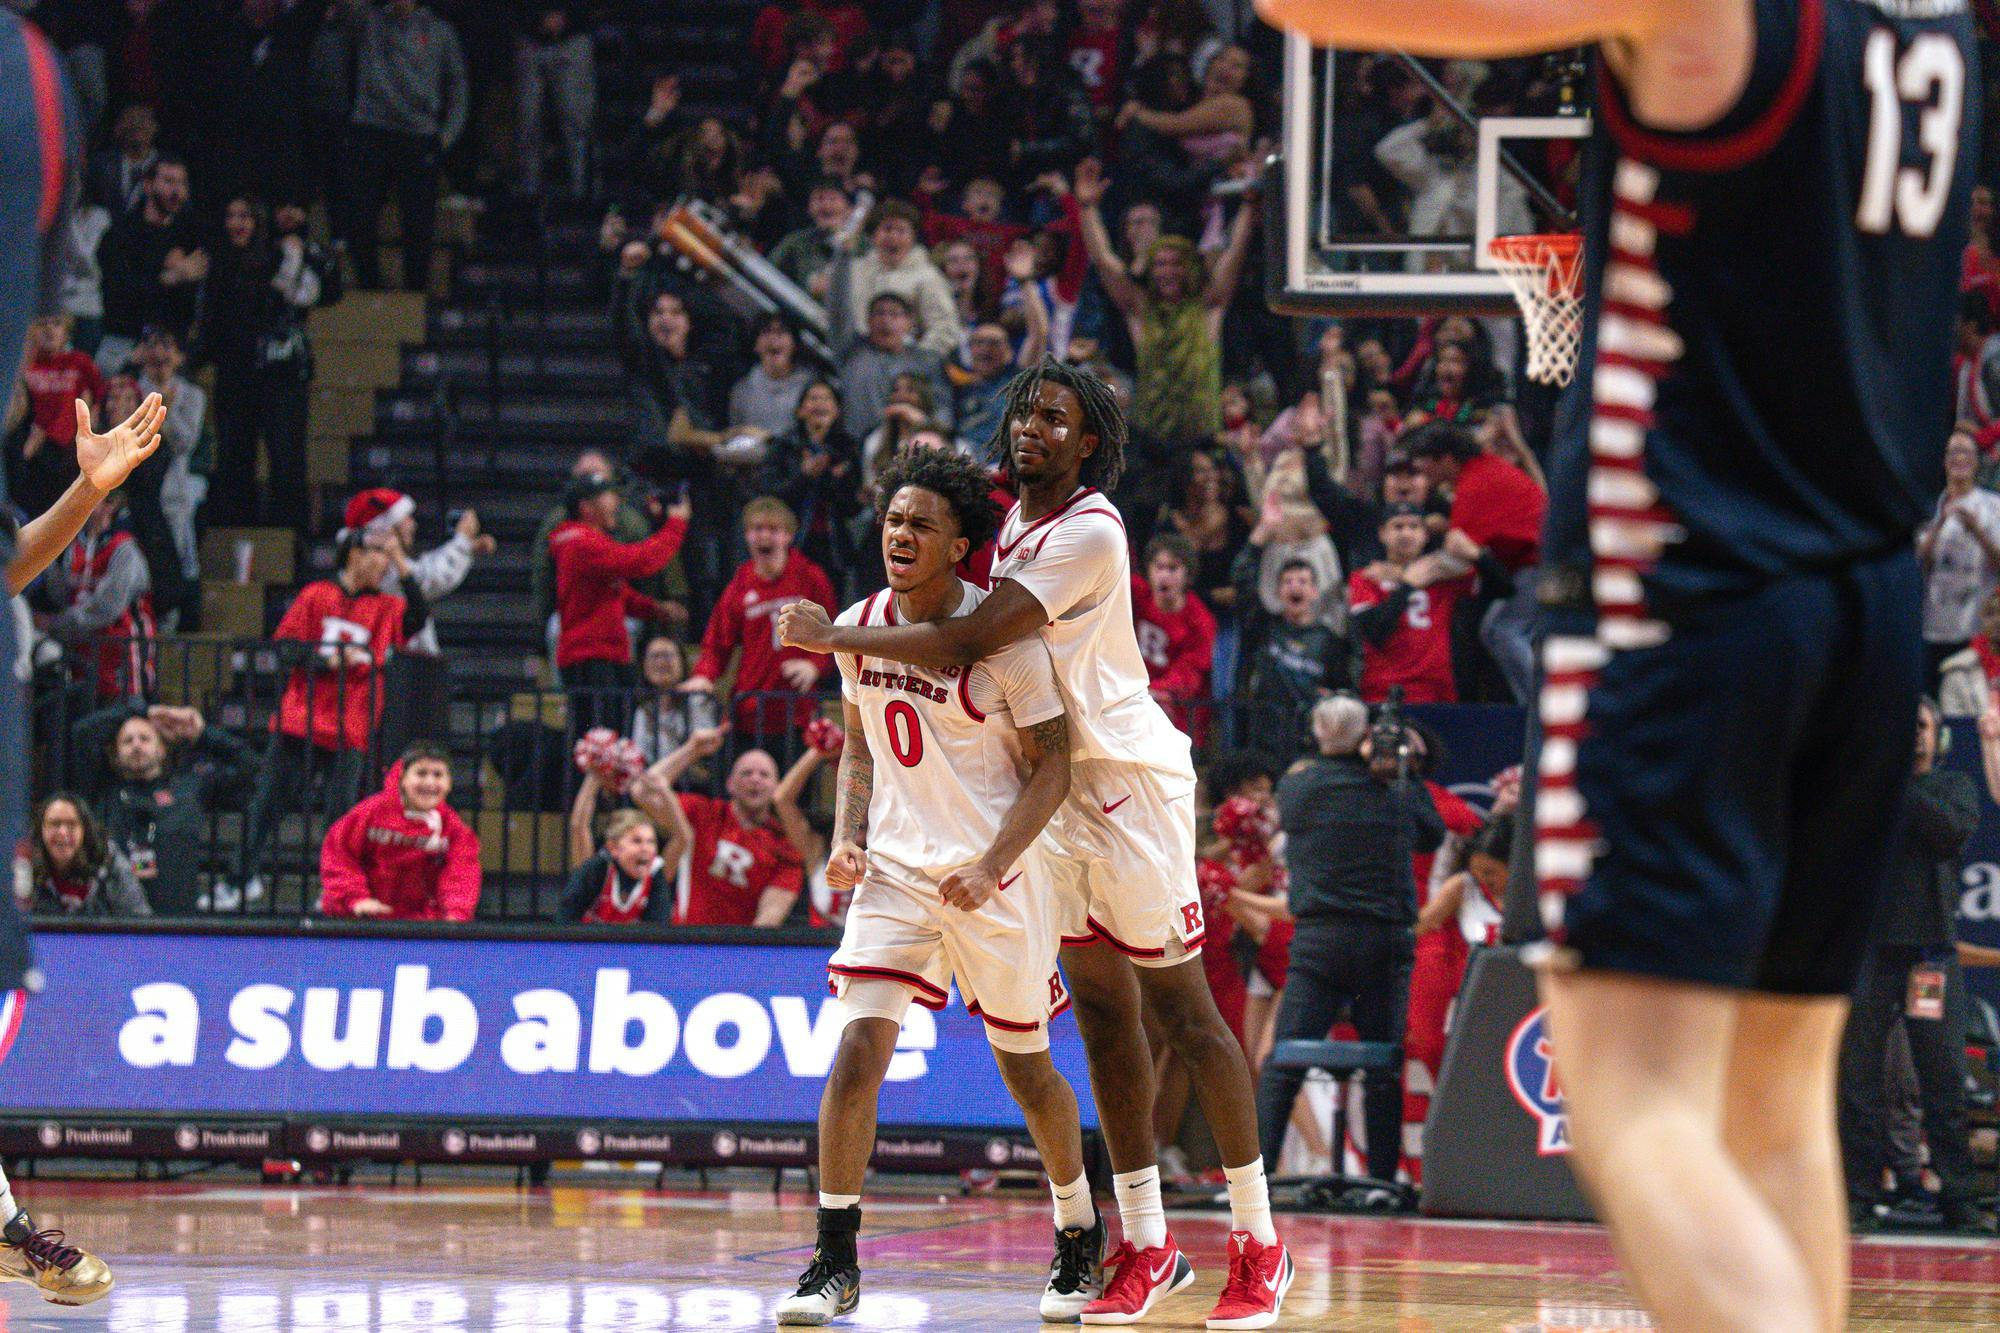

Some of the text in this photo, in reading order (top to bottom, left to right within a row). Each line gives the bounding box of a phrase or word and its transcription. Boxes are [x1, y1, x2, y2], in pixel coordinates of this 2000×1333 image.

[1857, 26, 1966, 238] 13
[1407, 590, 1432, 629] 2
[1138, 619, 1169, 667] R
[860, 669, 949, 704] RUTGERS
[885, 700, 924, 767] 0
[708, 839, 754, 888] R
[1180, 901, 1203, 935] R
[1048, 971, 1064, 1006] R
[117, 965, 937, 1081] a sub above
[65, 1129, 132, 1145] Prudential
[202, 1131, 269, 1147] Prudential
[332, 1132, 400, 1148] Prudential
[469, 1134, 536, 1150] Prudential
[603, 1135, 671, 1151] Prudential
[739, 1137, 807, 1153] Prudential
